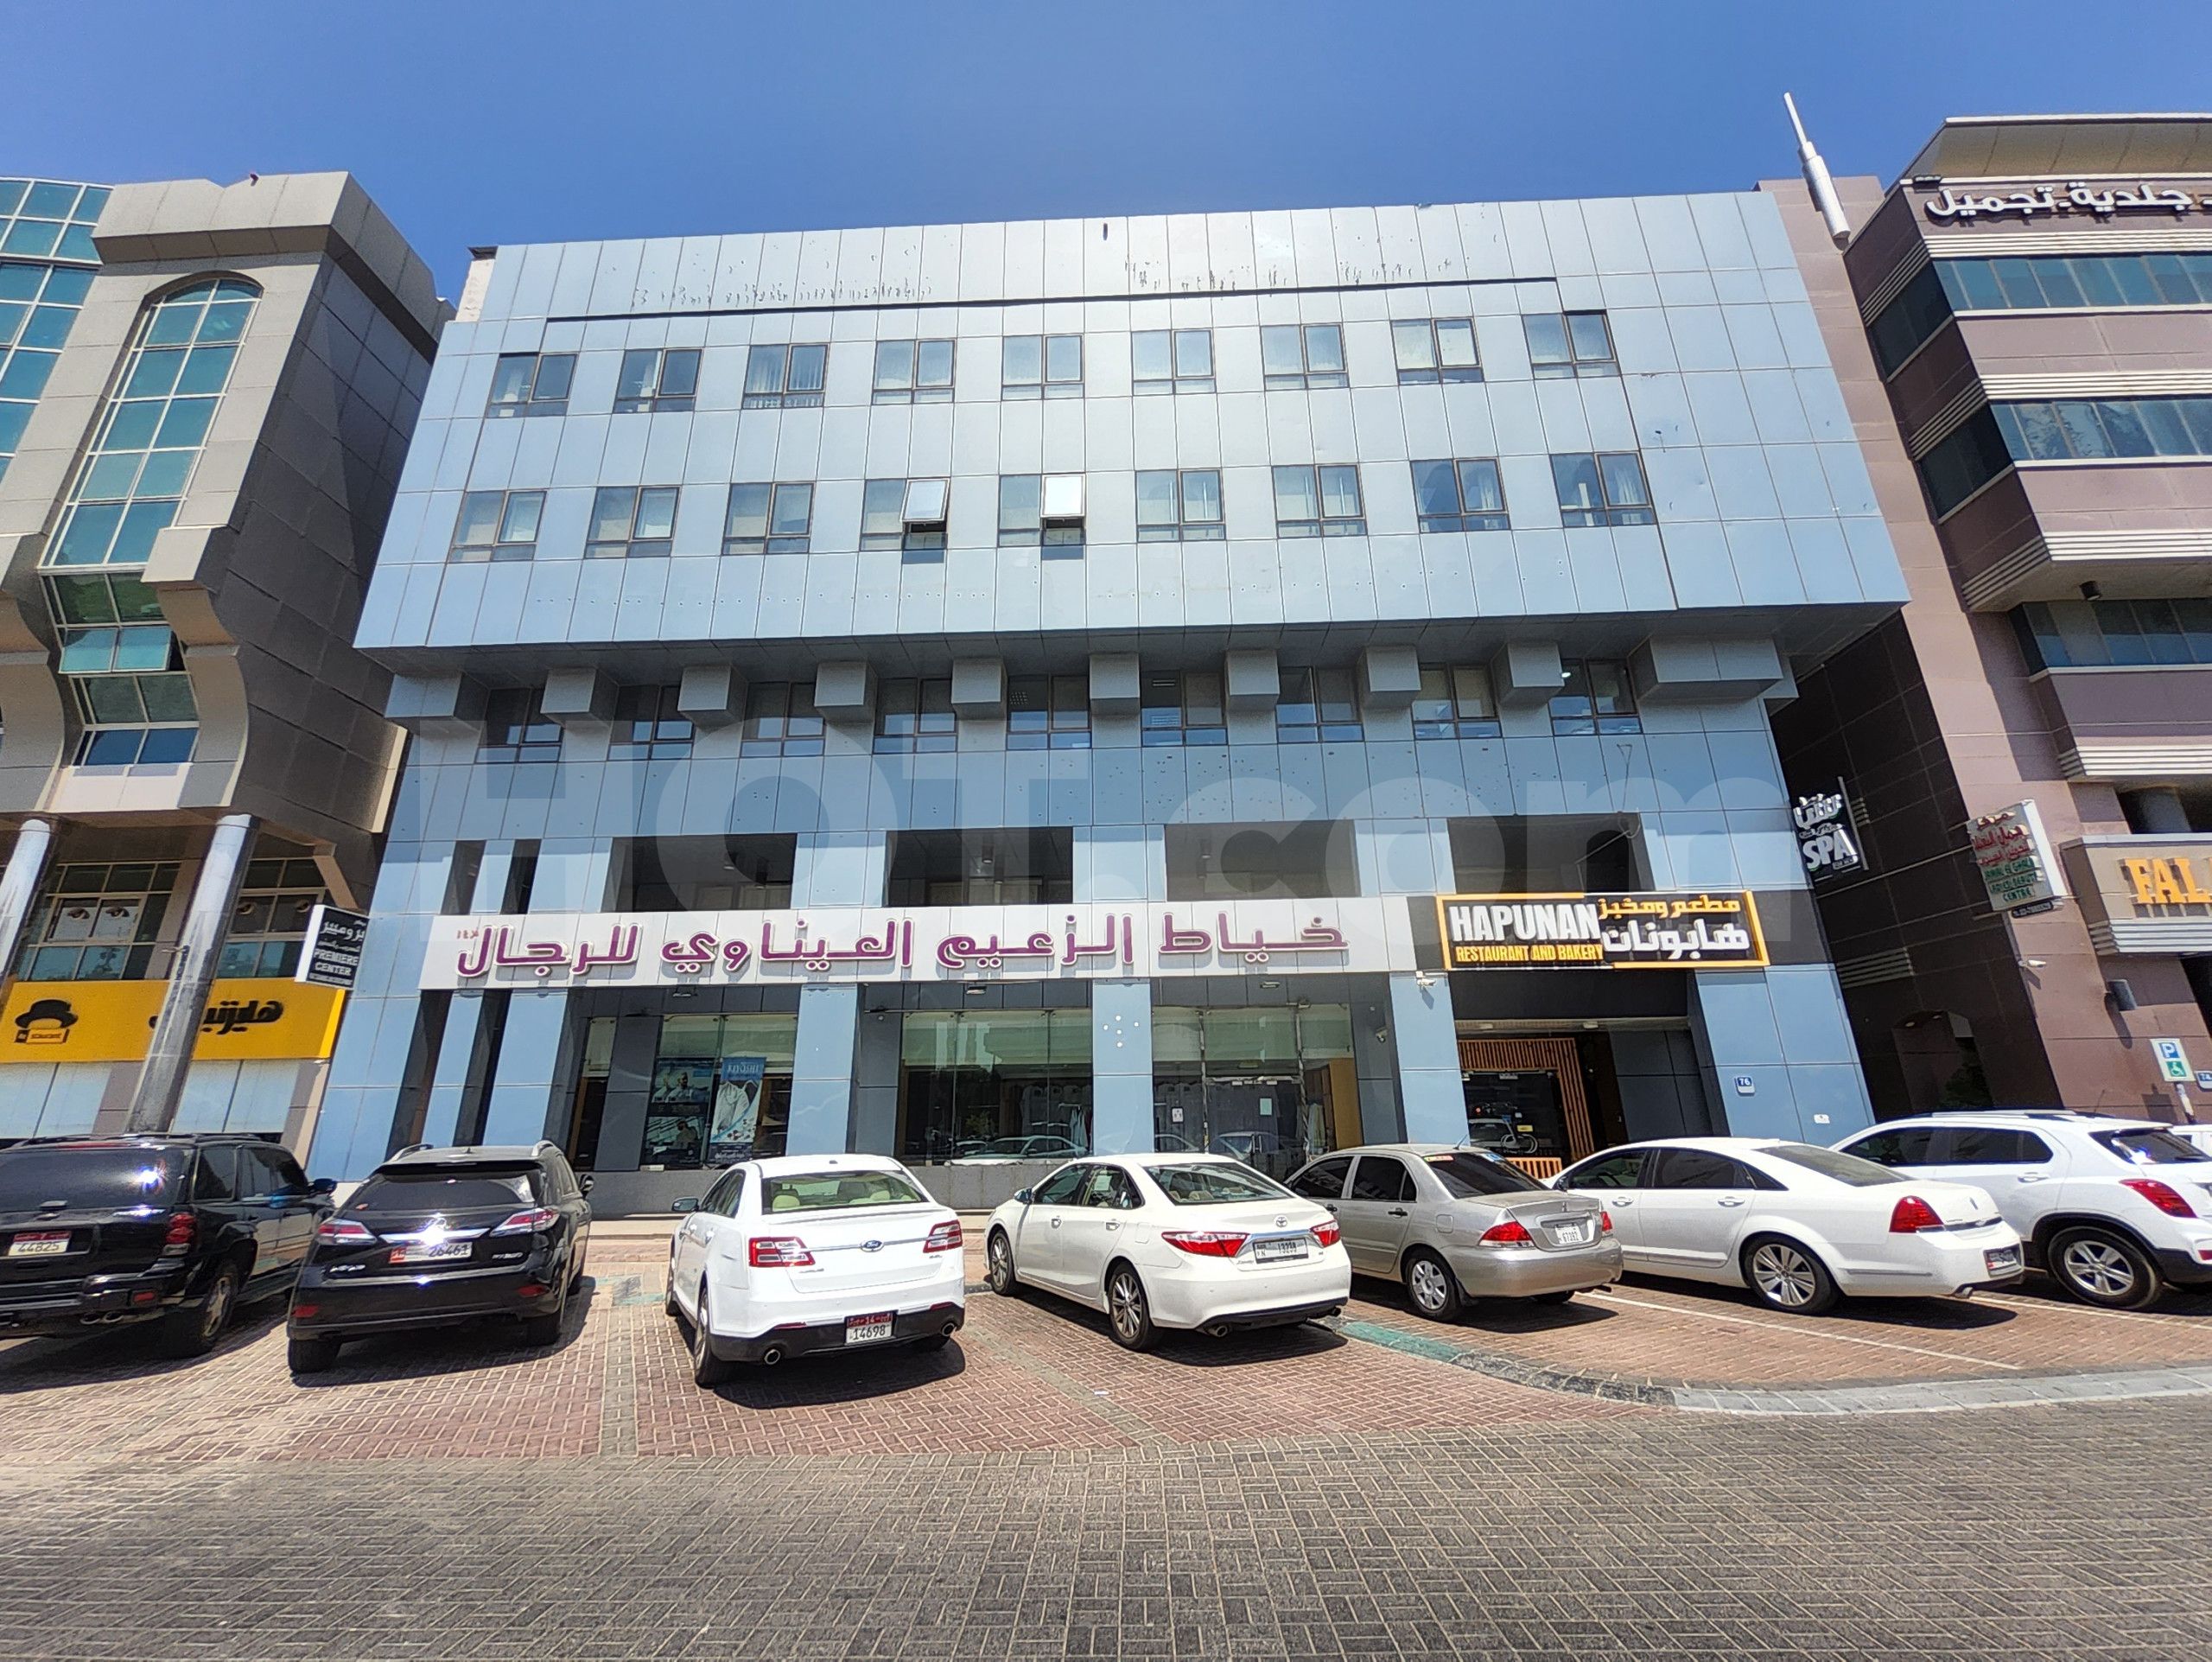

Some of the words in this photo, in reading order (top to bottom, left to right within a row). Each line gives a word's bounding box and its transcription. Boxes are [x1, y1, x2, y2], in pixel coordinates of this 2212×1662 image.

[1802, 830, 1857, 871] SPA
[2125, 857, 2212, 904] FAL
[1599, 897, 1669, 920] ومخبز
[1669, 895, 1741, 919] مطعم
[1448, 904, 1601, 942] HAPUNAN
[456, 921, 644, 977] للرجال
[660, 916, 916, 976] العيناوي
[935, 913, 1135, 968] الزعيم
[1158, 910, 1350, 965] خياط
[314, 948, 360, 966] PREMIERE
[1455, 946, 1529, 962] RESTAURANT
[1530, 945, 1556, 961] AND
[1557, 944, 1604, 960] BAKERY
[315, 961, 353, 976] CENTER
[2161, 1042, 2176, 1058] P
[17, 1242, 60, 1252] 44825
[853, 1324, 887, 1340] 14698
